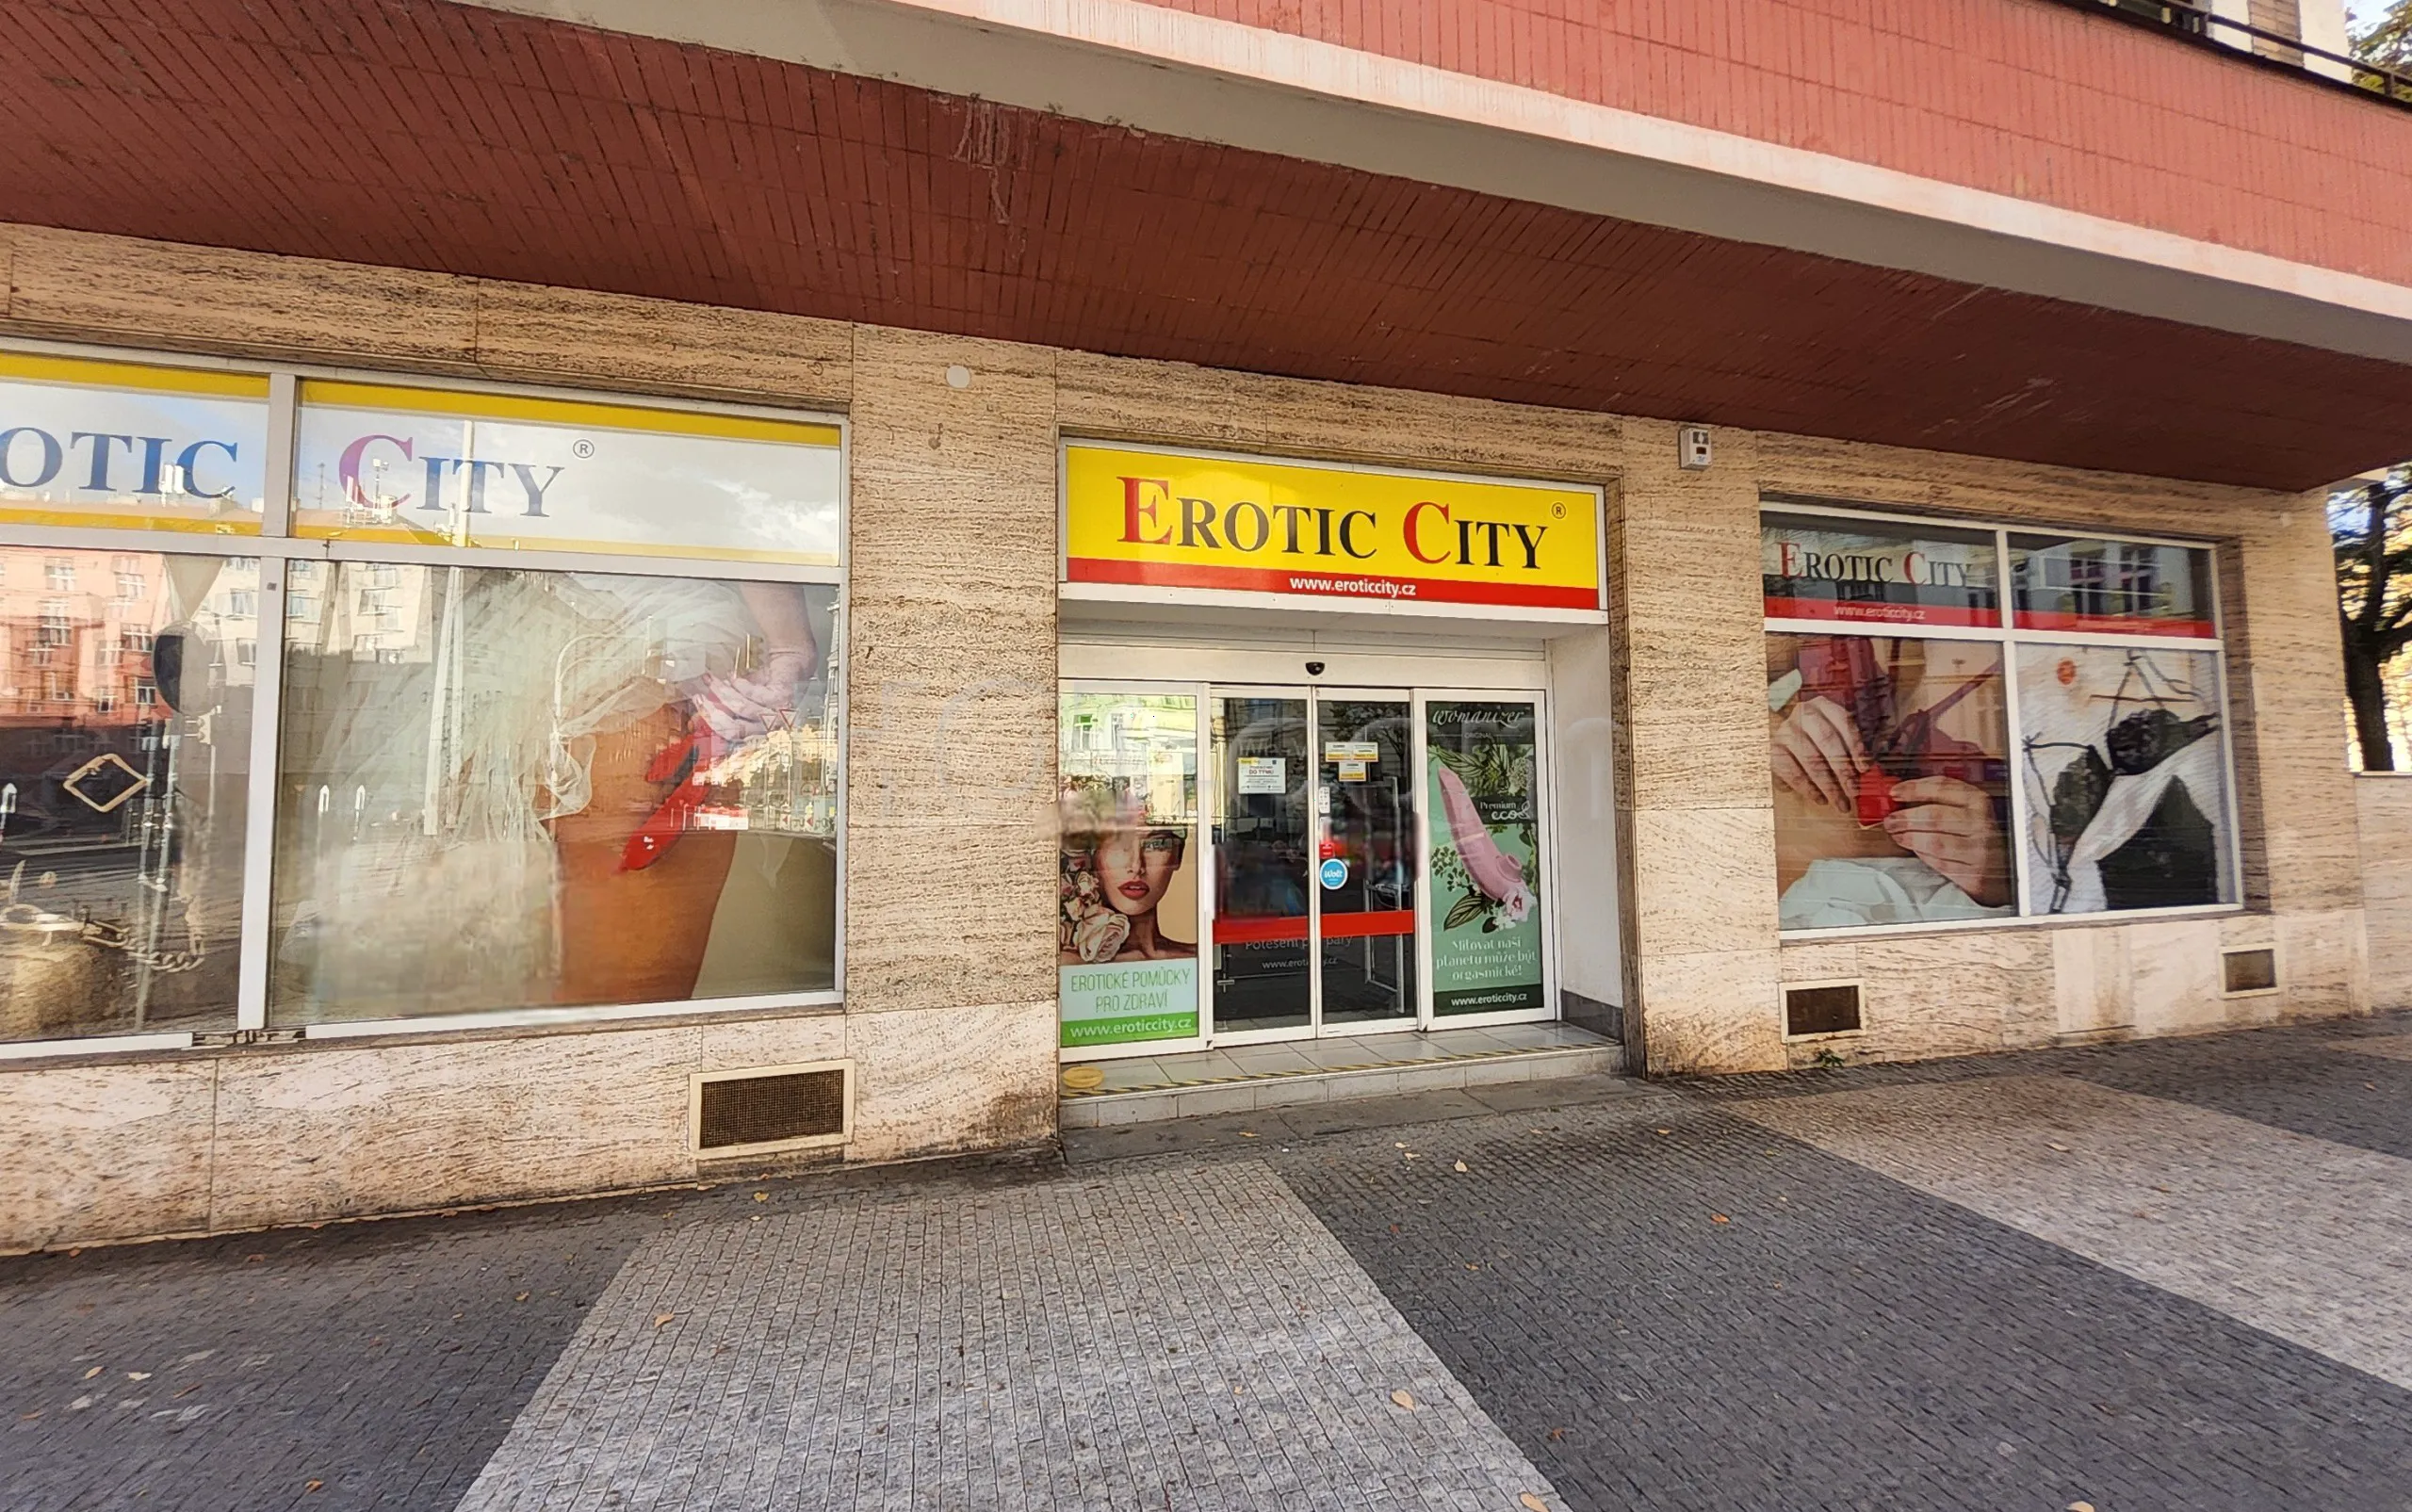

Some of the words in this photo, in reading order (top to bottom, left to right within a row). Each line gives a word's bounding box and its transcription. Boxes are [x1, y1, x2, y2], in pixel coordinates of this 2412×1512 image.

[338, 434, 565, 517] CITY
[1116, 476, 1377, 560] EROTIC
[1403, 501, 1548, 570] CITY
[1778, 541, 1894, 583] EROTIC
[1903, 550, 1973, 588] CITY
[1289, 575, 1417, 599] www.eroticcity.cz
[1833, 605, 1927, 622] www.eroticcity.cz
[1480, 801, 1516, 810] Premium
[1324, 870, 1343, 878] Wolt
[1436, 954, 1481, 970] planetu
[1070, 970, 1129, 992] EROTICKÉ
[1133, 967, 1190, 988] POMŮCKY
[1096, 995, 1120, 1013] PRO
[1123, 989, 1168, 1011] ZDRAVÍ
[1451, 993, 1527, 1006] www.eroticcity.cz
[1070, 1017, 1192, 1038] www.eroticcity.cz
